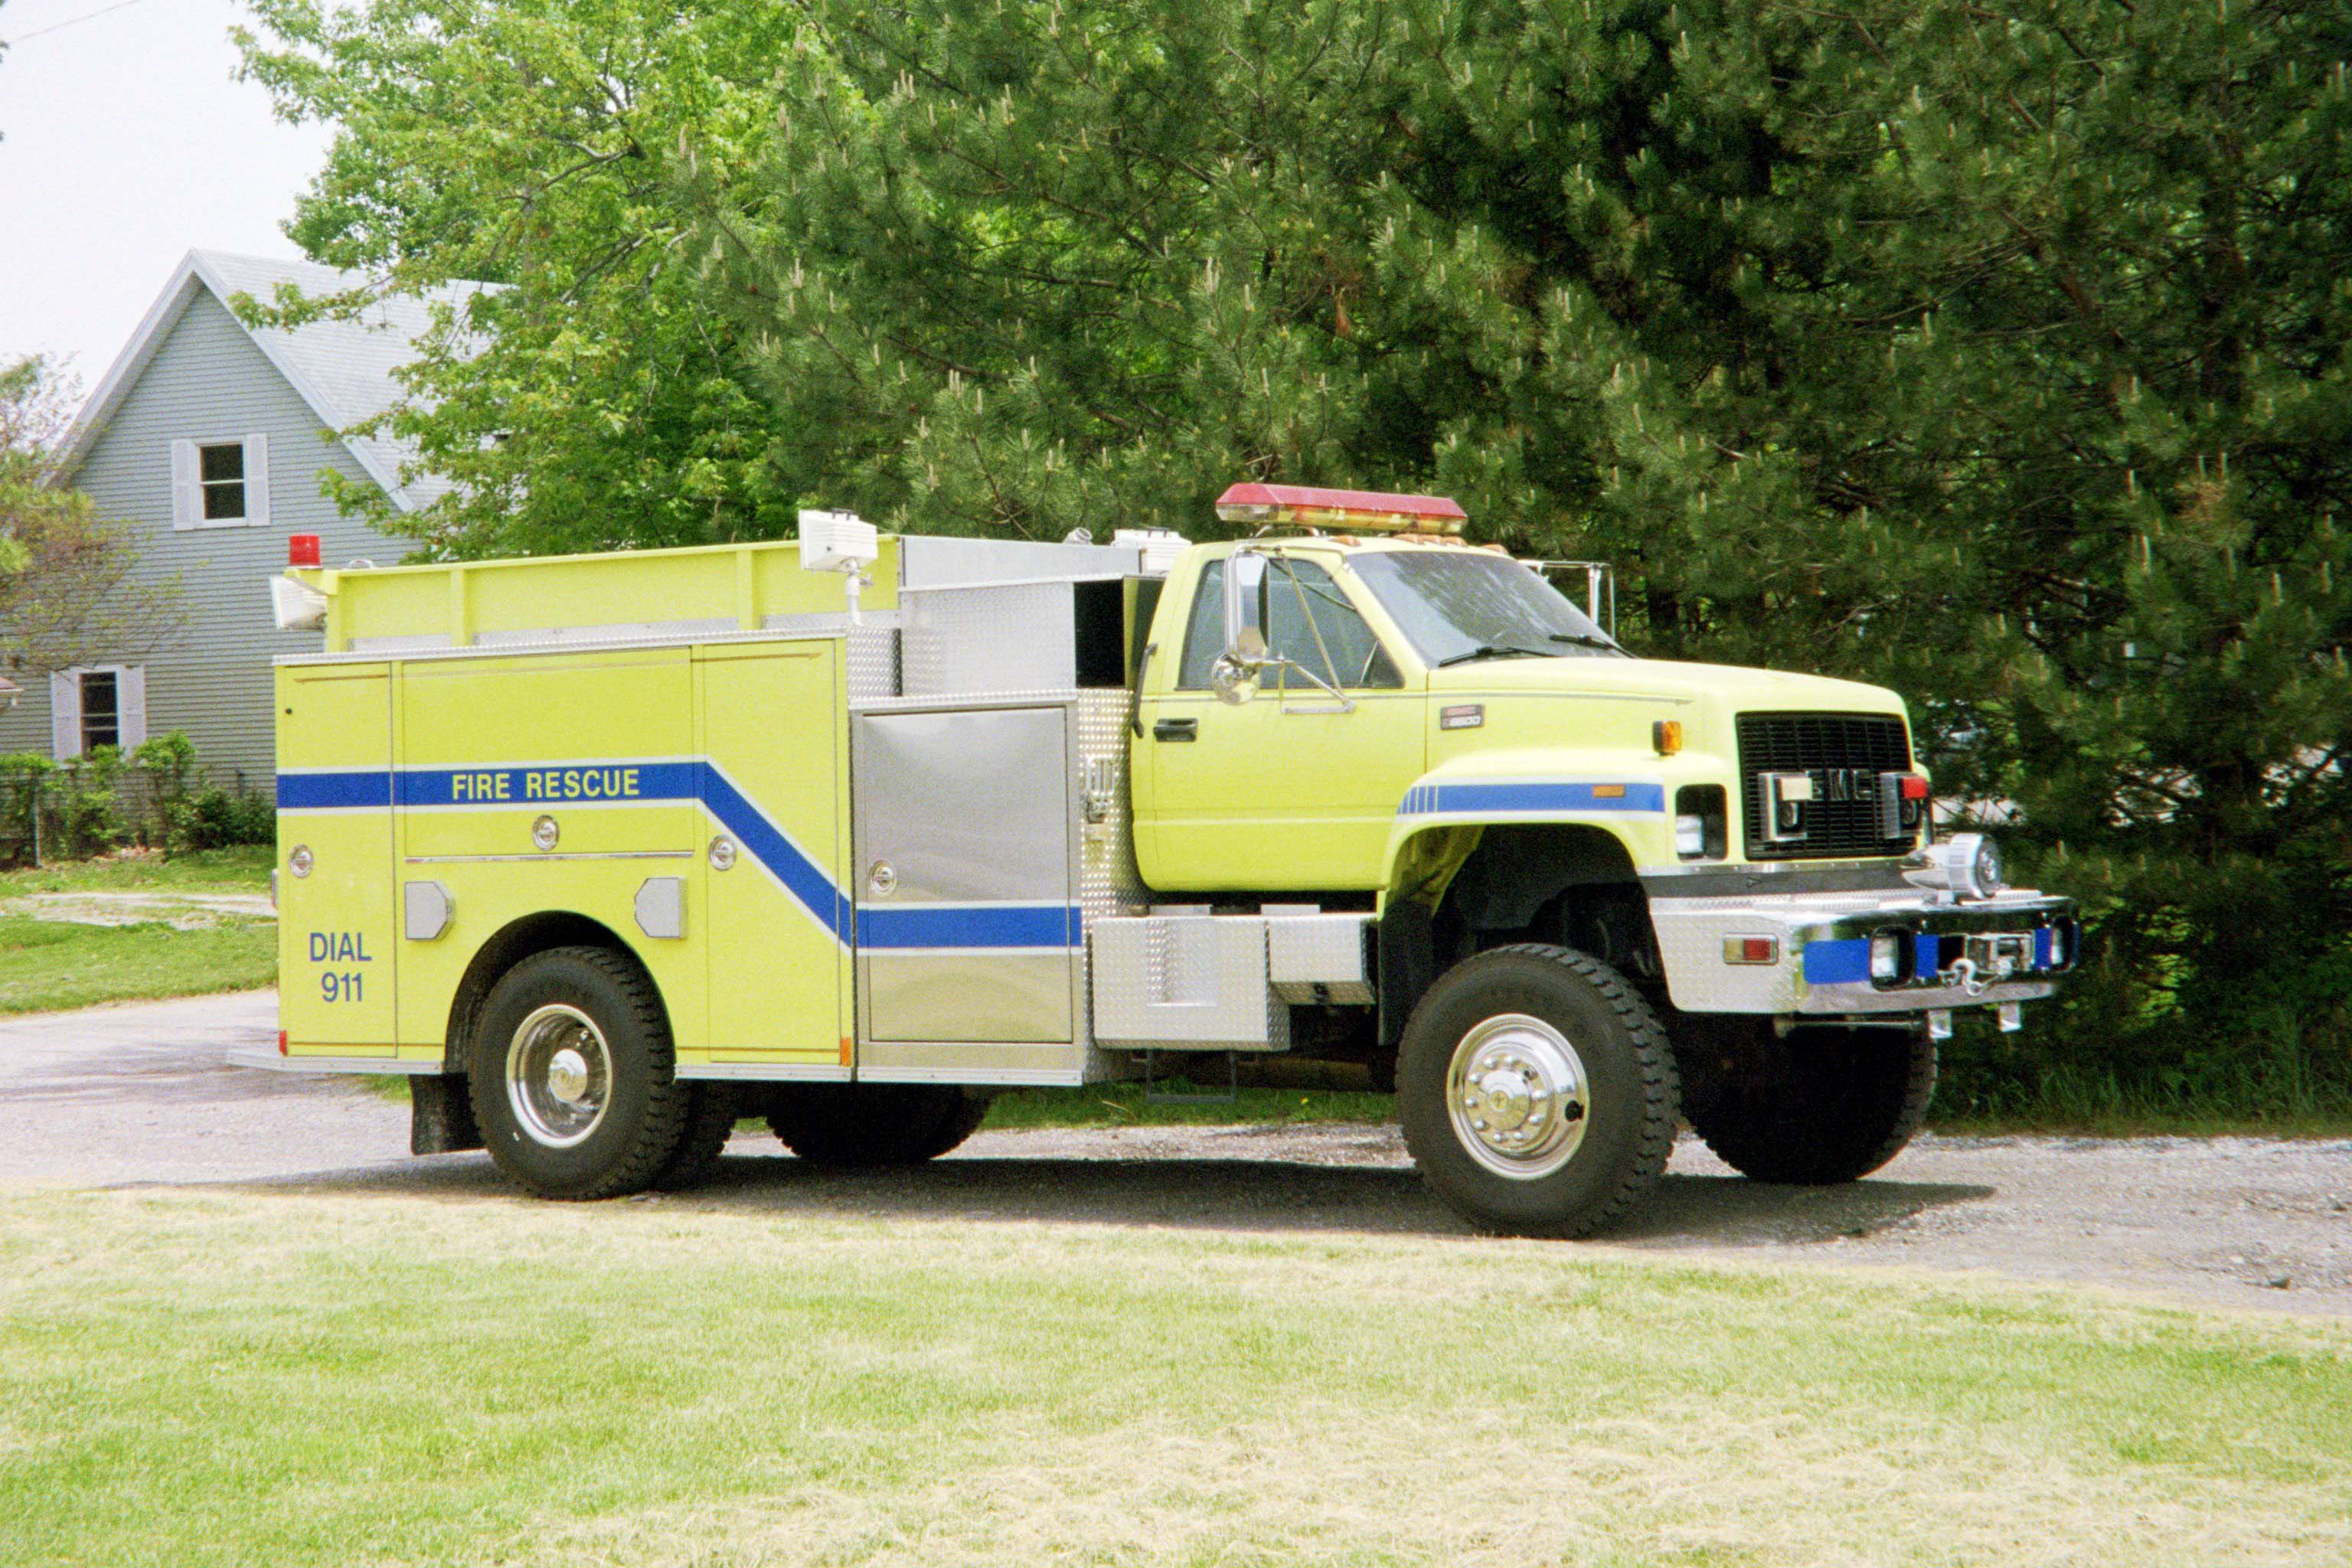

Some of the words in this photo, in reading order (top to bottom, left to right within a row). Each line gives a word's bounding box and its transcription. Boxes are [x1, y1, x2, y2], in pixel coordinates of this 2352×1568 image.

[452, 773, 511, 800] FIRE
[526, 769, 640, 799] RESCUE
[309, 931, 373, 962] DIAL
[322, 972, 362, 1003] 911
